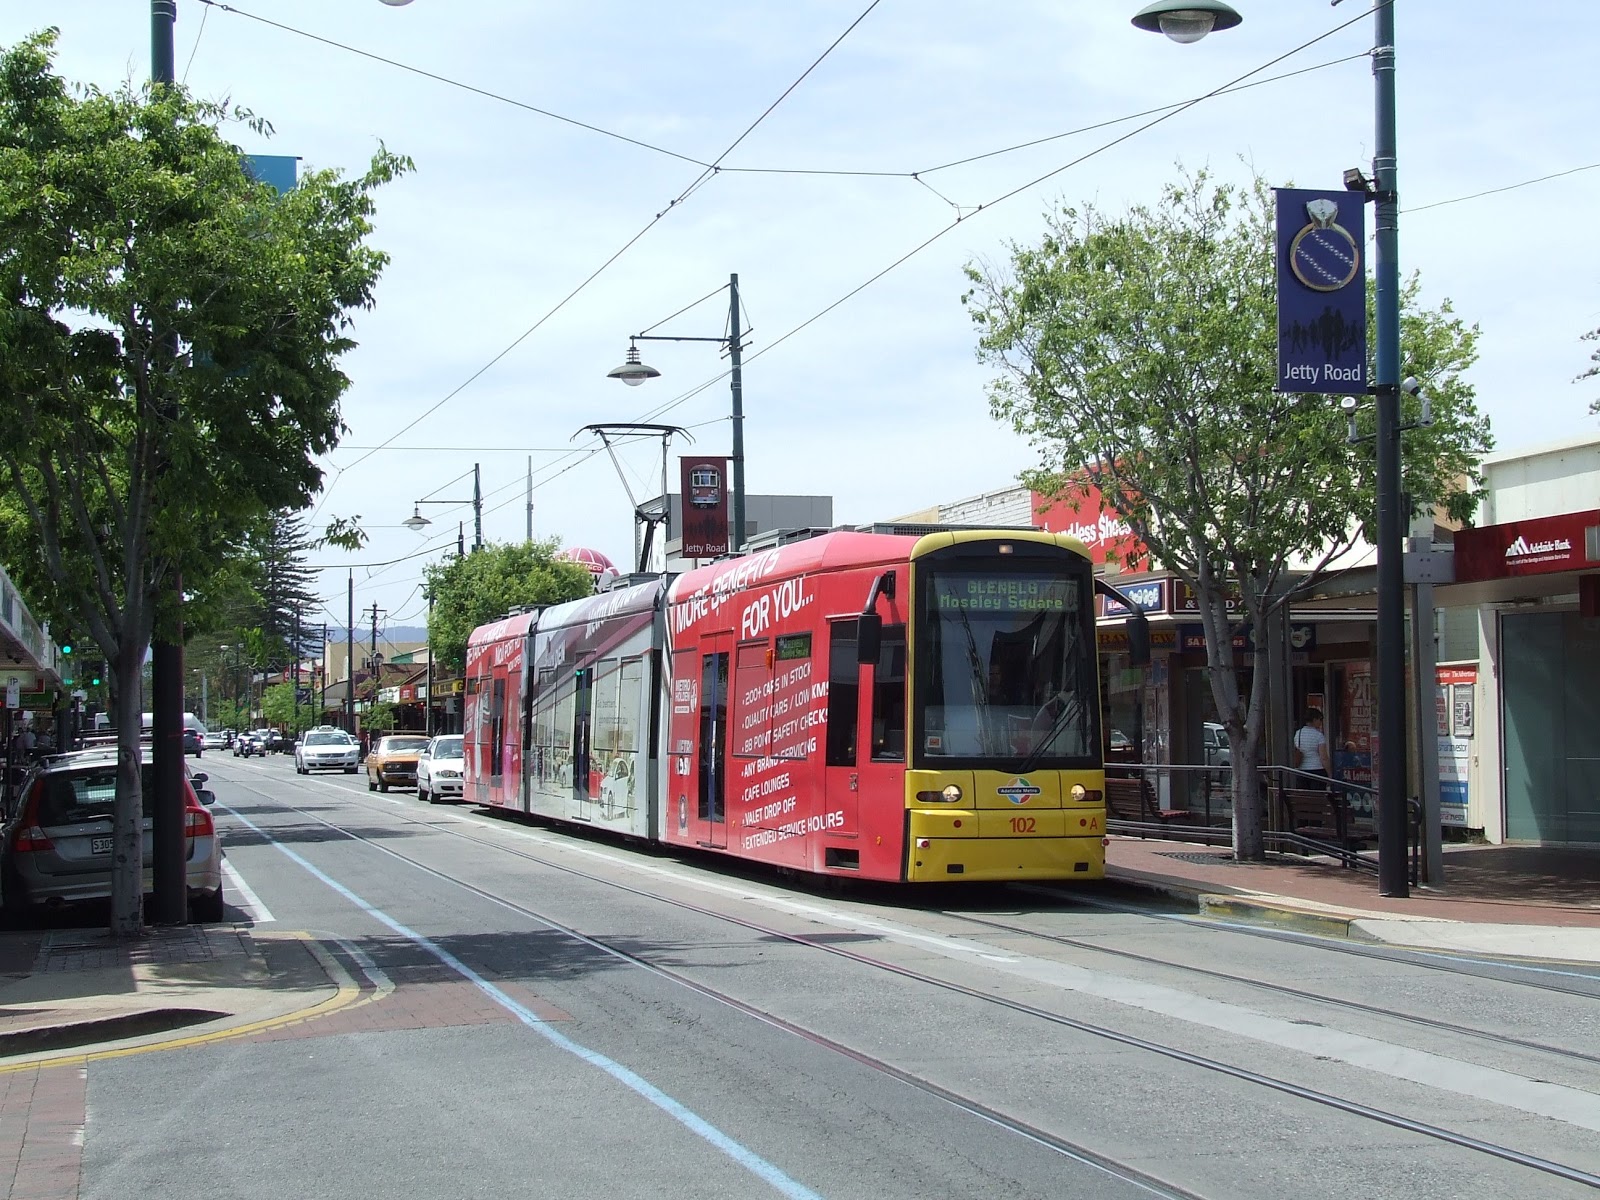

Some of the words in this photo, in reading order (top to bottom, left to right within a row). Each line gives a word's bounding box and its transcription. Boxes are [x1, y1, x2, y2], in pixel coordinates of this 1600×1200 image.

[1284, 362, 1319, 384] Jetty
[1324, 363, 1361, 381] Road
[685, 544, 705, 555] Jetty
[706, 543, 726, 553] Road
[1555, 538, 1571, 550] Bank
[676, 583, 710, 634] MORE
[711, 550, 780, 611] BENEFITS
[967, 580, 1039, 595] GLENELG
[939, 595, 1001, 610] Moseley
[1008, 595, 1063, 610] Square
[742, 594, 770, 640] FOR
[1187, 638, 1200, 646] SA
[745, 685, 762, 706] 200+
[762, 677, 780, 698] CARS
[781, 673, 789, 689] IN
[789, 662, 812, 685] STOCK
[744, 709, 770, 730] QUALITY
[794, 689, 810, 708] LOW
[773, 719, 799, 743] SAFETY
[744, 761, 757, 778] ANY
[757, 753, 779, 772] BRAND
[780, 737, 817, 764] SERVICING
[744, 783, 760, 802] CAFE
[760, 772, 790, 796] LOUNGES
[1001, 786, 1021, 794] Adelaide
[744, 808, 763, 827] VALET
[763, 801, 781, 818] DROP
[782, 796, 797, 812] OFF
[745, 829, 777, 851] EXTENDED
[778, 821, 806, 845] SERVICE
[807, 810, 844, 834] HOURS
[1009, 817, 1036, 833] 102
[1090, 817, 1098, 830] A
